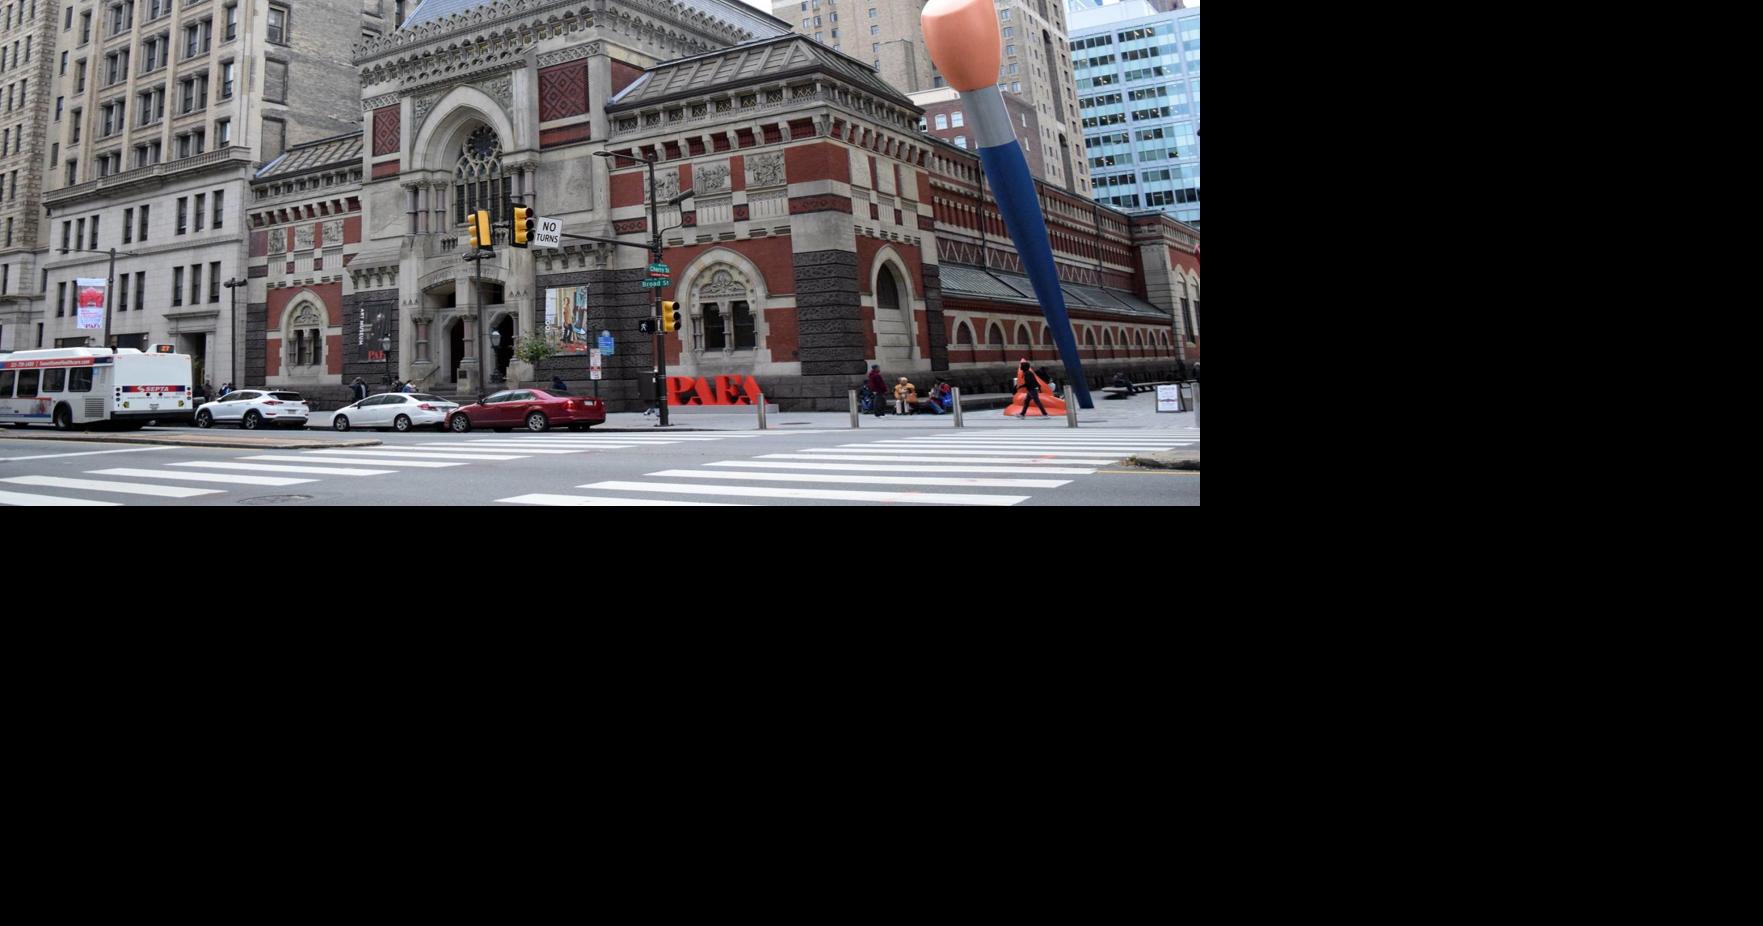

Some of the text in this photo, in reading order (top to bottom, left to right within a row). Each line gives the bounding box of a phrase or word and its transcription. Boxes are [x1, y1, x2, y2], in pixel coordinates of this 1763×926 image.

[542, 221, 556, 232] NO
[537, 233, 558, 243] TURNS
[642, 280, 661, 288] Broad
[368, 351, 385, 360] PAF
[666, 375, 767, 405] PAFA
